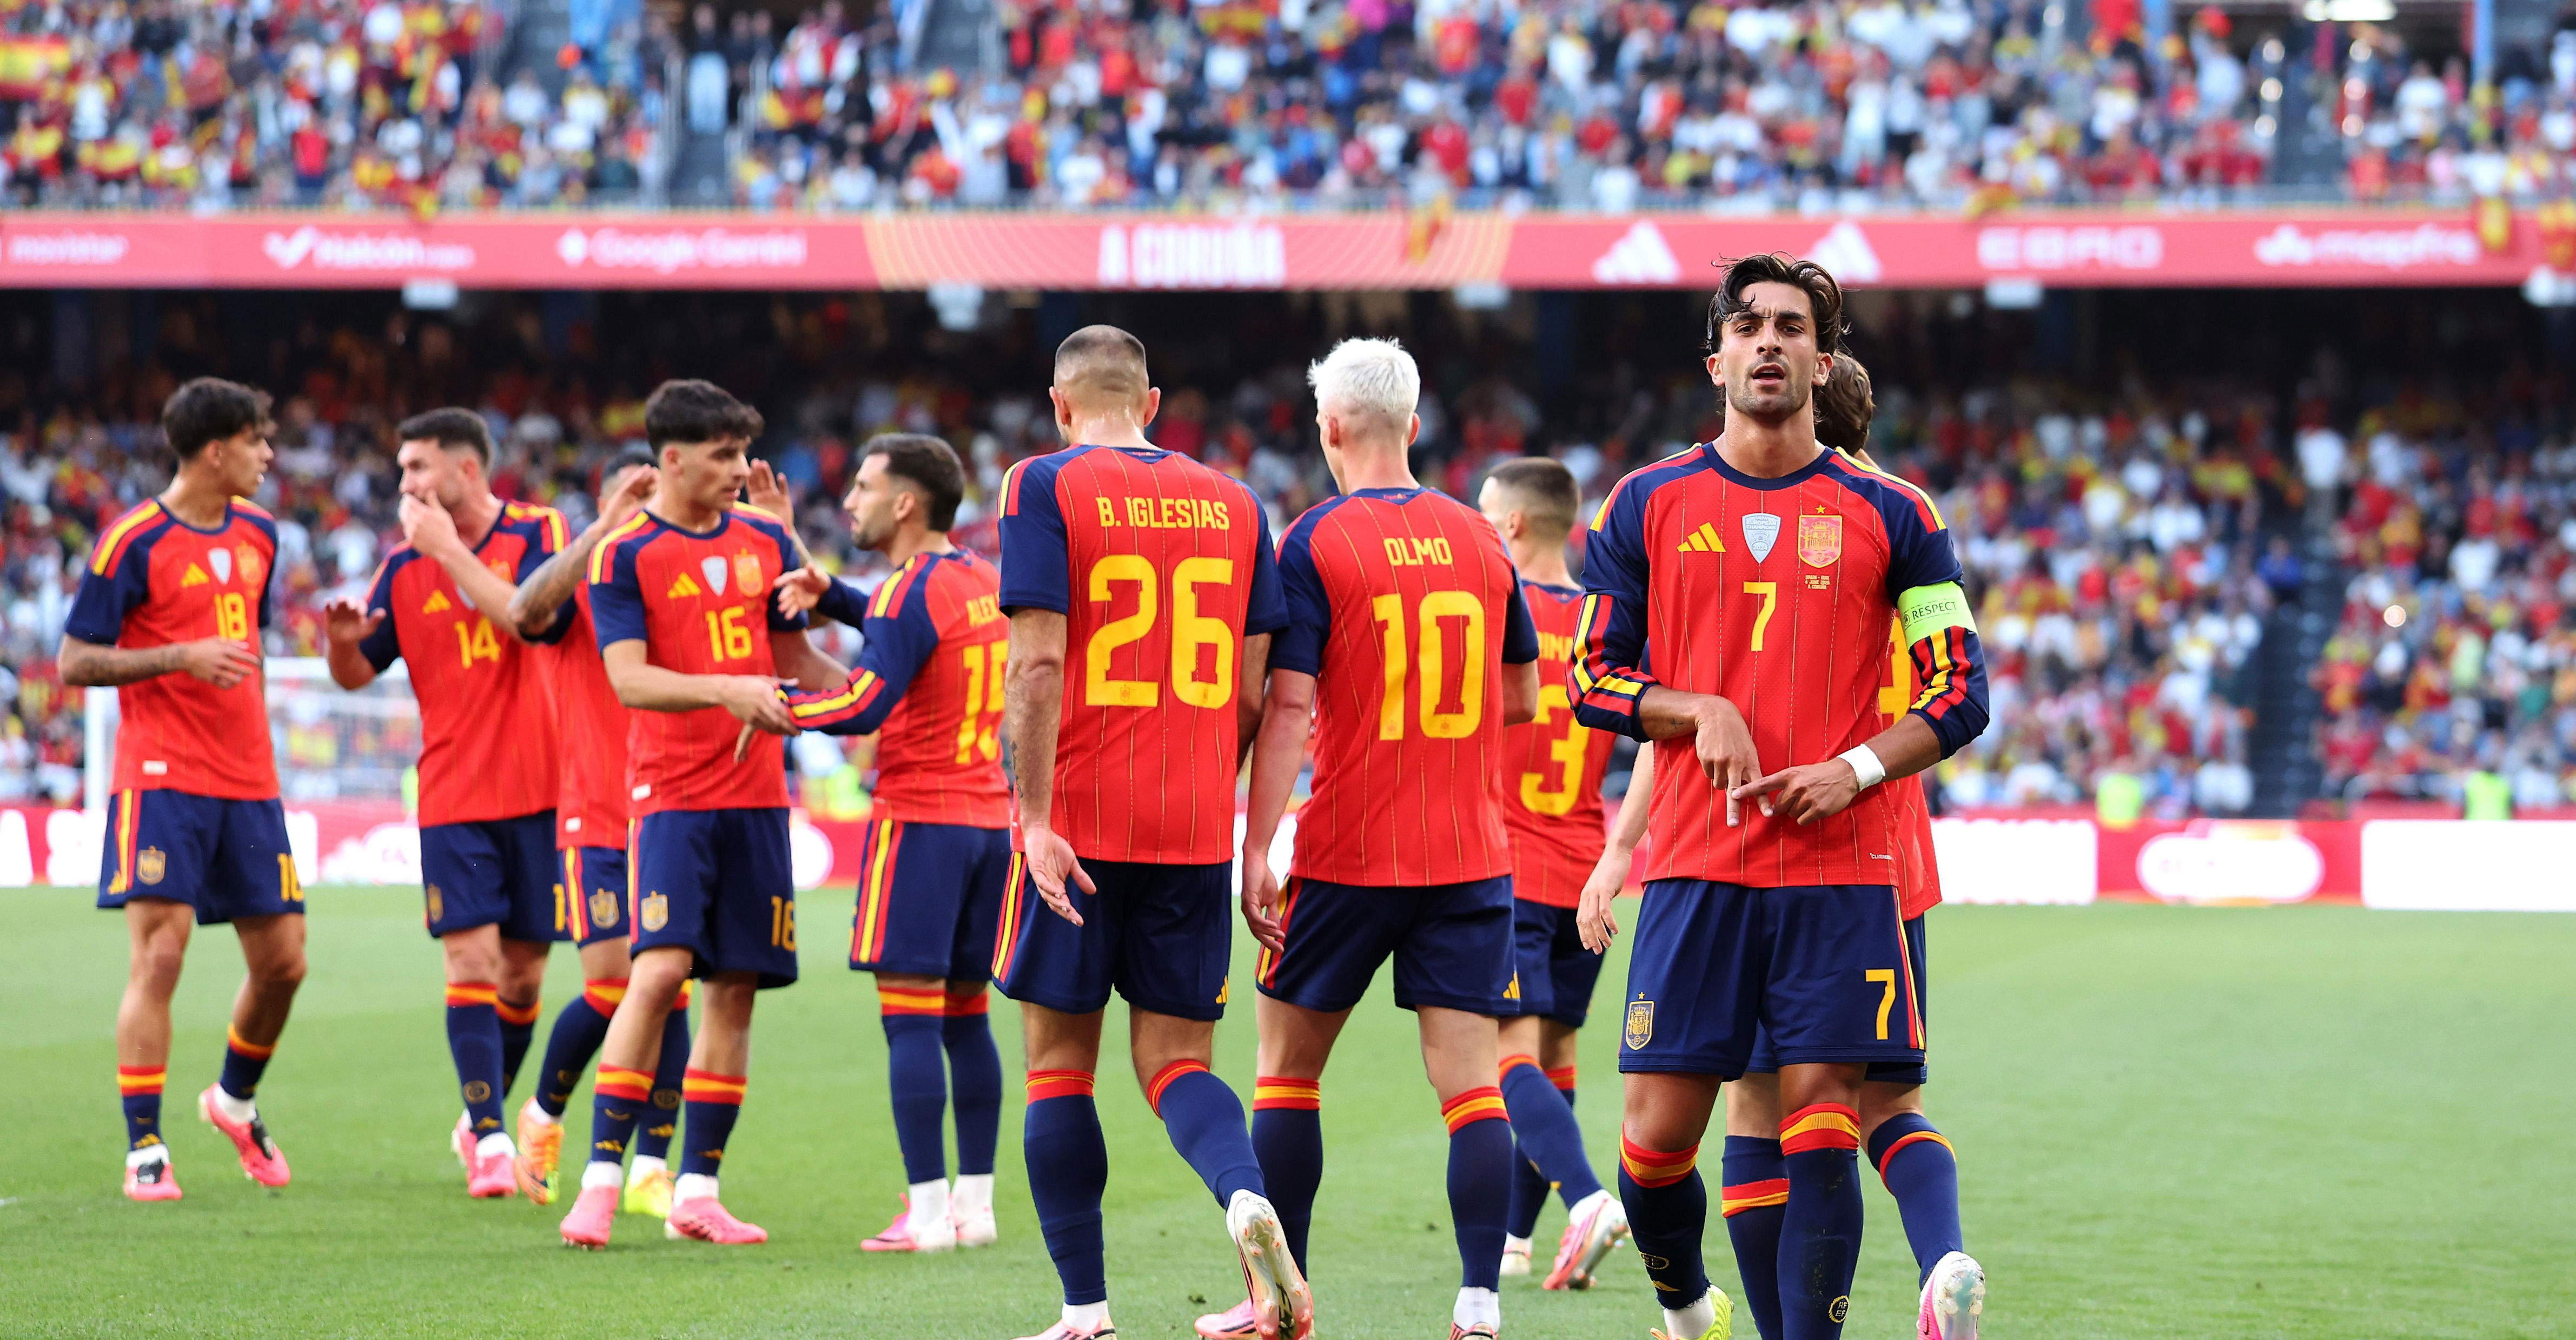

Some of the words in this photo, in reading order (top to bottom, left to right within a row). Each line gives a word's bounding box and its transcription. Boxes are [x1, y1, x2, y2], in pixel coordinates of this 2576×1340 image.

[1095, 497, 1121, 527] B.
[1125, 497, 1230, 530] IGLESIAS
[1383, 537, 1454, 566] OLMO
[214, 592, 249, 641] 18
[705, 605, 752, 663] 16
[1085, 555, 1234, 709] 26
[1743, 581, 1778, 652] 7
[1912, 602, 1957, 620] RESPECT
[454, 618, 501, 670] 14
[1372, 590, 1485, 741] 10
[1520, 684, 1590, 816] 3
[1865, 968, 1896, 1040] 7
